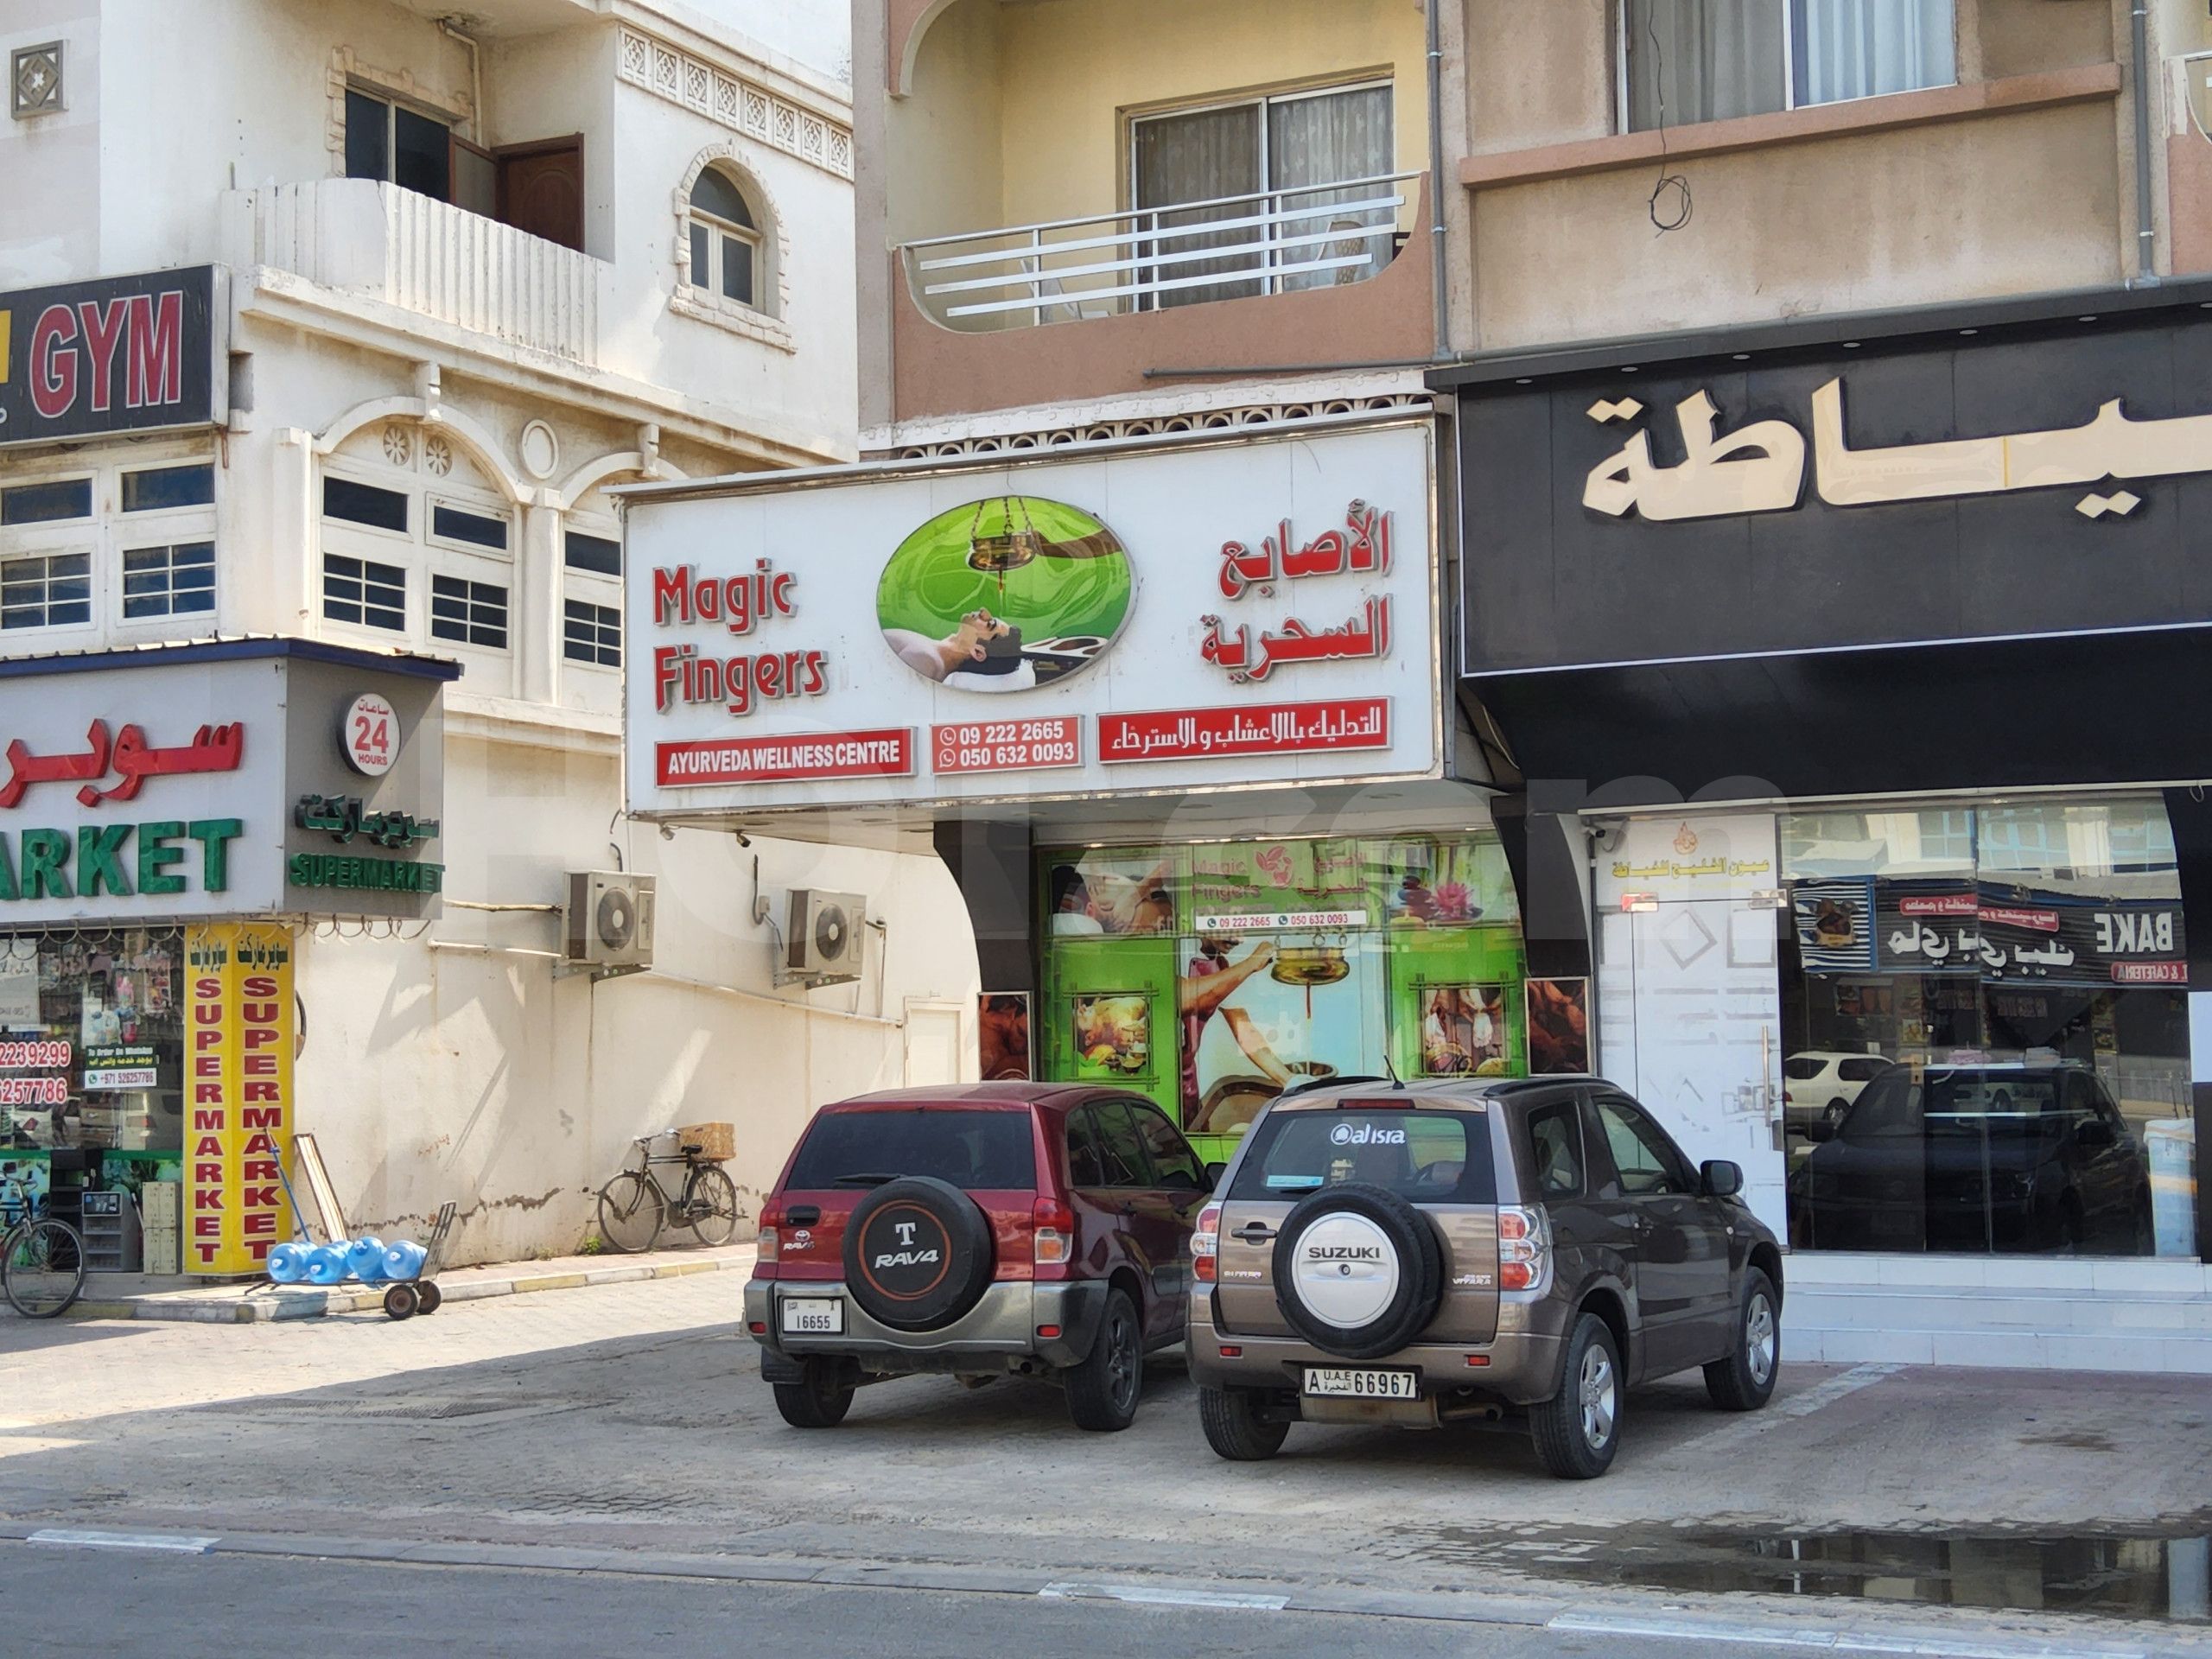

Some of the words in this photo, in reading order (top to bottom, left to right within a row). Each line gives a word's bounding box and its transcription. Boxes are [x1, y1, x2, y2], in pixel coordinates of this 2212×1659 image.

[30, 290, 182, 418] GYM
[1217, 498, 1395, 601] الأصابع
[652, 558, 798, 636] Magic
[1200, 593, 1393, 683] السحرية
[653, 644, 829, 717] Fingers
[358, 699, 389, 715] ساعات
[354, 716, 389, 753] 24
[959, 727, 980, 745] 09
[985, 724, 1016, 743] 222
[1021, 721, 1064, 741] 2665
[1111, 717, 1196, 754] الاسترخاء
[1308, 706, 1381, 742] للتدليك
[1202, 729, 1211, 751] و
[359, 753, 388, 766] HOURS
[669, 748, 750, 775] AYURVEDA
[752, 743, 834, 771] WELLNESS
[835, 741, 900, 766] CENTRE
[960, 747, 991, 766] 050
[996, 745, 1027, 765] 632
[1032, 742, 1074, 762] 0093
[290, 853, 446, 893] SUPERMARKET
[1192, 885, 1262, 902] Fingers
[1219, 917, 1230, 928] 09
[1233, 917, 1247, 927] 222
[1250, 916, 1271, 926] 2665
[1291, 916, 1306, 925] 050
[1309, 915, 1325, 925] 632
[1327, 913, 1348, 925] 0093
[0, 1077, 67, 1104] 257786
[194, 977, 226, 1263] SUPERMARKET
[242, 976, 283, 1260] SUPERMARKET
[895, 1222, 916, 1246] T
[874, 1249, 939, 1268] RAV4
[1308, 1247, 1381, 1258] SUZUKI
[797, 1315, 830, 1329] 16655
[1309, 1370, 1320, 1392] A
[1355, 1372, 1413, 1395] 66967
